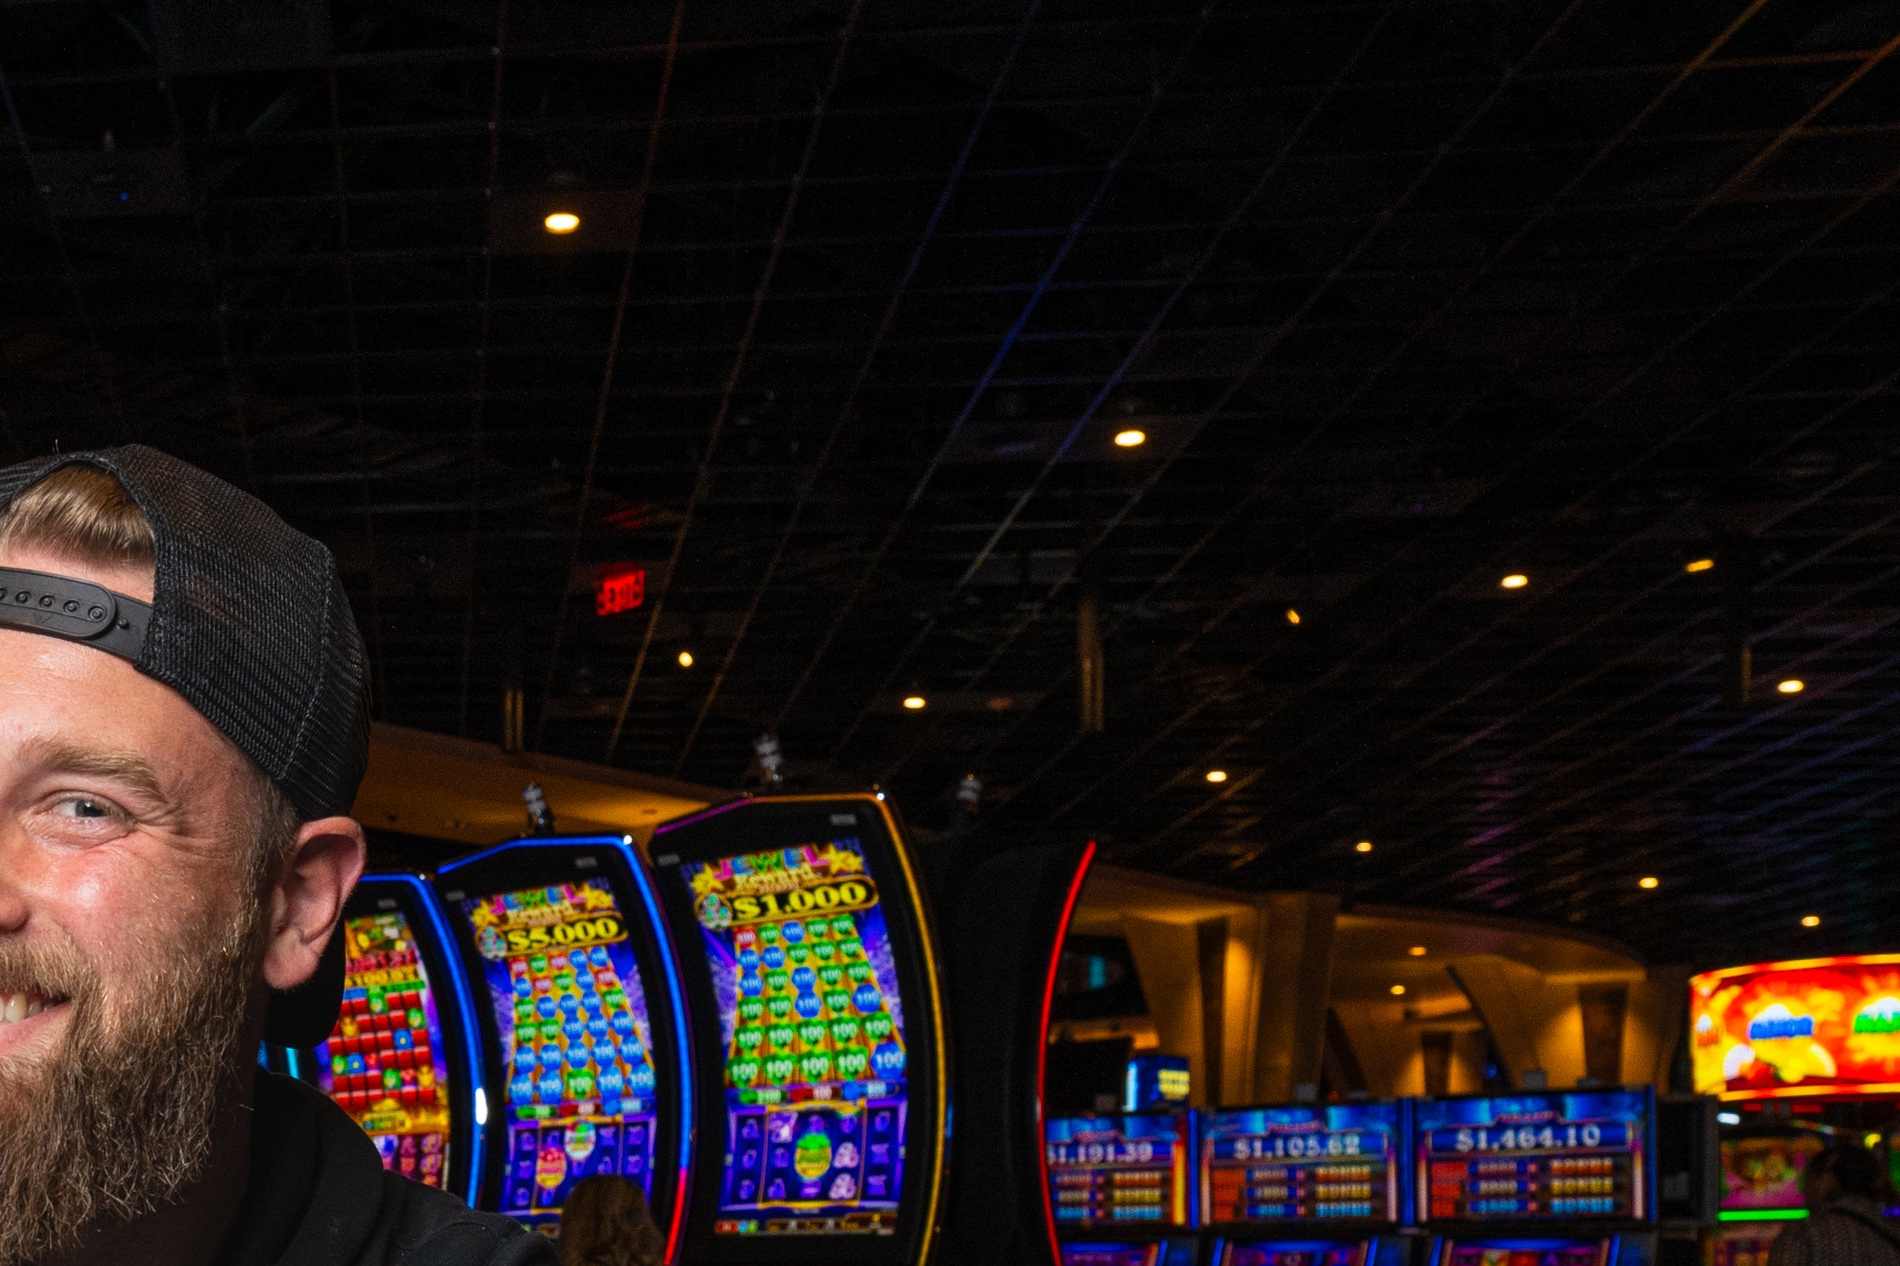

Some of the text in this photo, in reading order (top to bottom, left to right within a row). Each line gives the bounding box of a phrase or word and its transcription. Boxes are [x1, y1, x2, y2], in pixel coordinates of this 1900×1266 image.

[713, 845, 830, 880] JEWEL
[490, 885, 586, 915] JEWEL
[732, 1052, 903, 1076] 100 100 100 100 100
